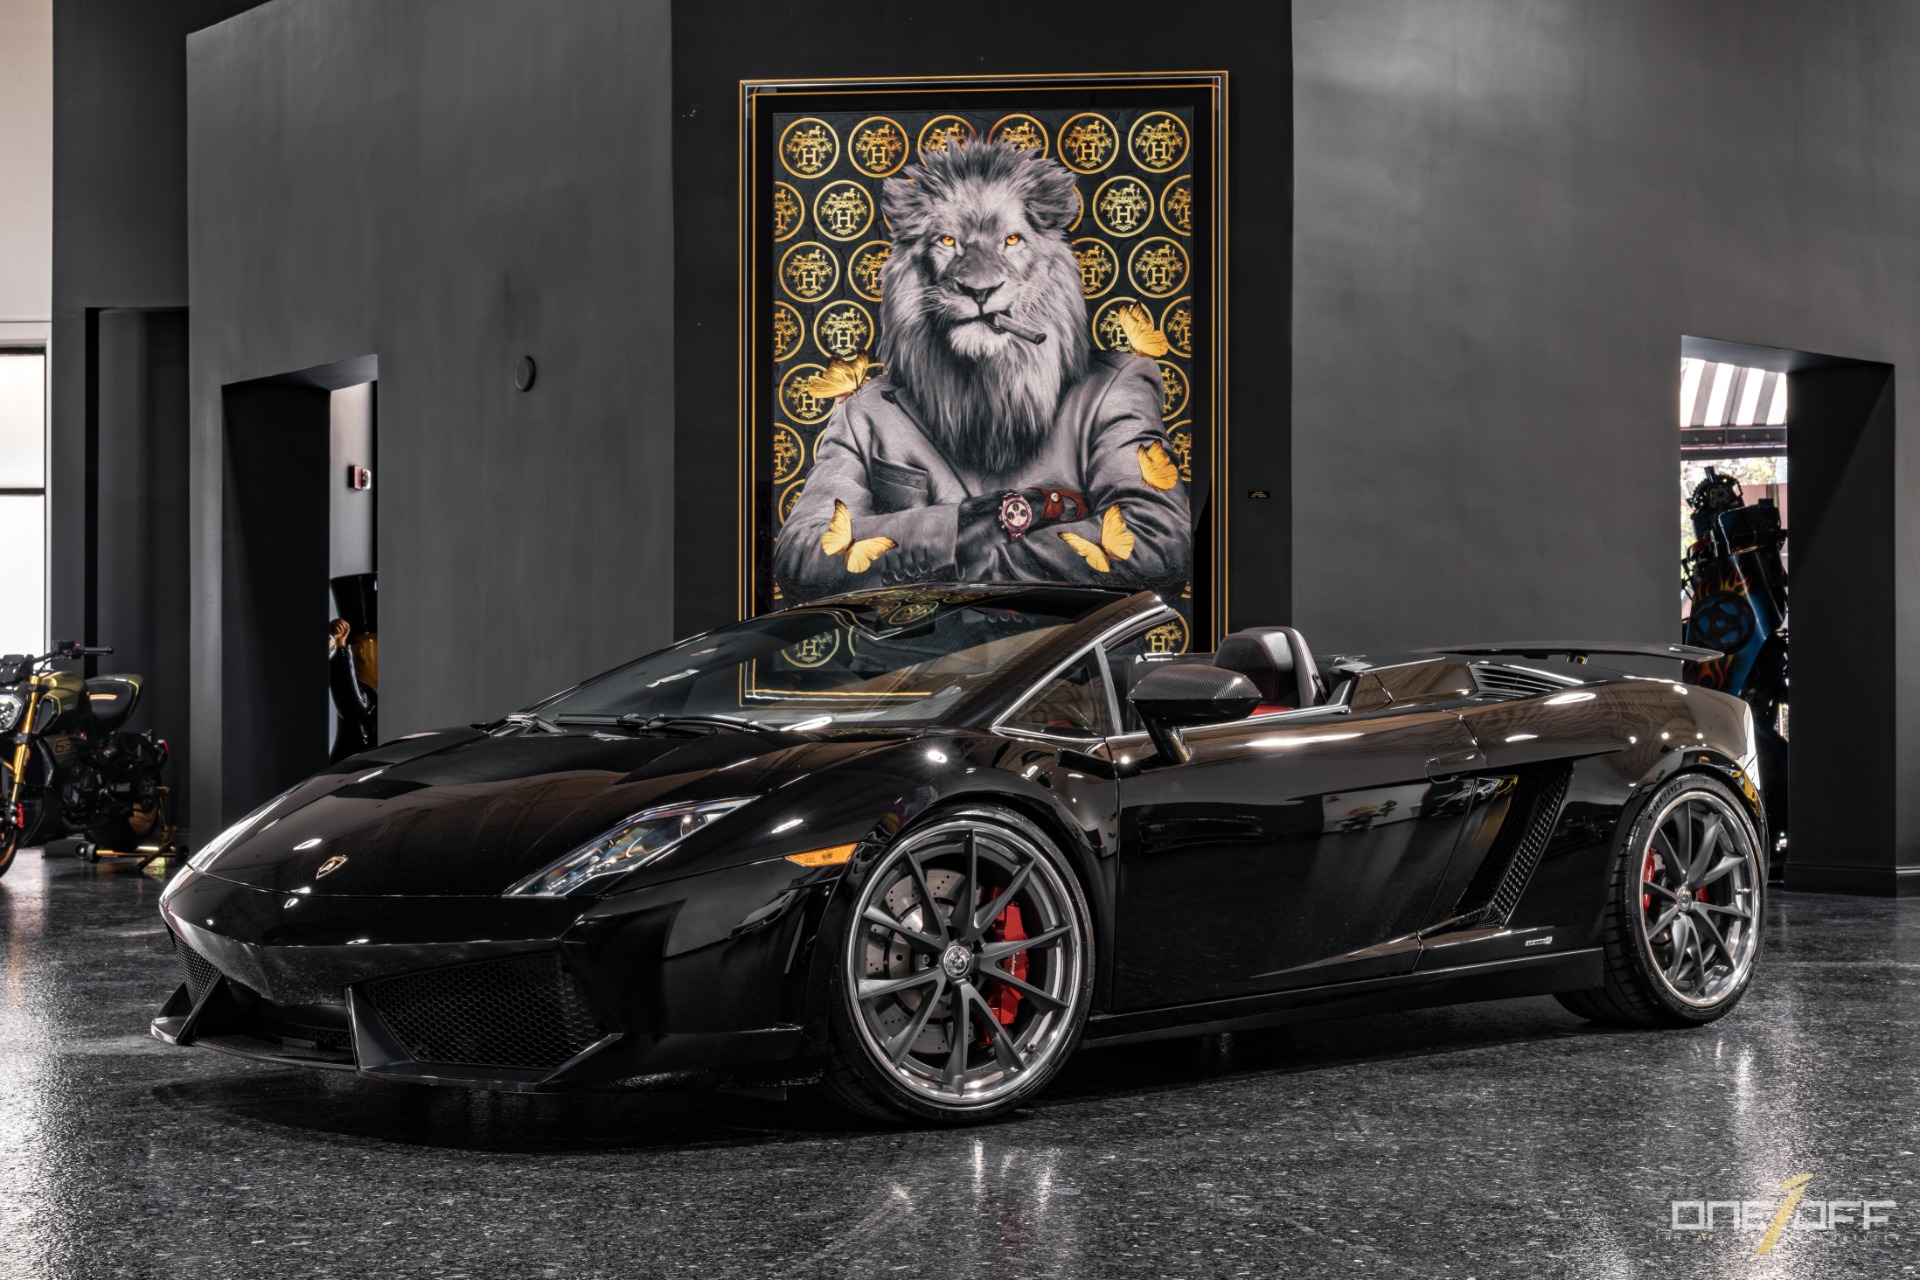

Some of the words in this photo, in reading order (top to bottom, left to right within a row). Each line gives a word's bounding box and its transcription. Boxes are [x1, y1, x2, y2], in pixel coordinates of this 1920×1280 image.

[801, 147, 818, 165] H
[871, 146, 888, 164] H
[1080, 142, 1098, 160] H
[1151, 141, 1168, 159] H
[835, 210, 853, 228] H
[1116, 205, 1133, 224] H
[801, 271, 818, 289] H
[1081, 267, 1098, 285] H
[1151, 266, 1168, 285] H
[835, 330, 853, 348] H
[801, 393, 818, 411] H
[802, 639, 819, 656] H
[1150, 635, 1167, 653] H
